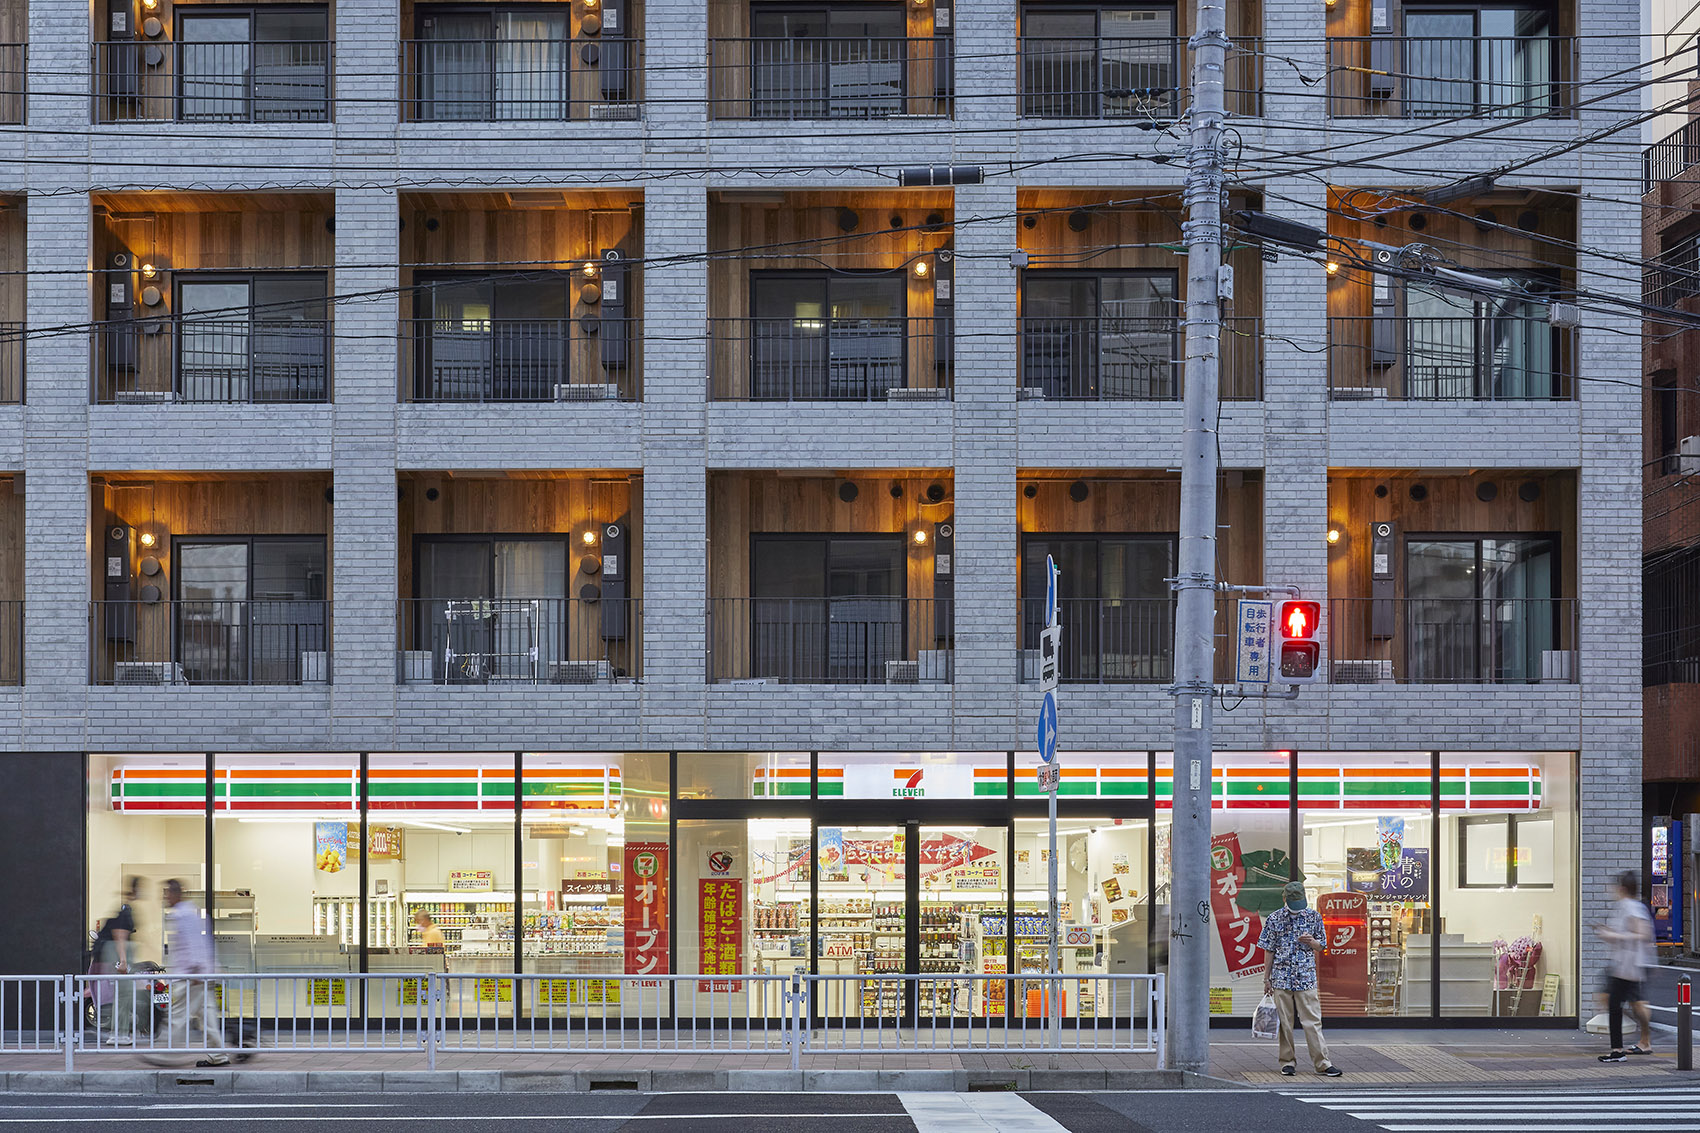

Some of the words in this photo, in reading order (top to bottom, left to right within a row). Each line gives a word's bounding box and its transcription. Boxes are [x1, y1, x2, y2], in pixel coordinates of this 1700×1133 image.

[1244, 608, 1256, 647] 自転車
[1255, 609, 1267, 648] 歩行者
[1248, 651, 1260, 677] 専用
[566, 884, 611, 893] スイーツ売場
[1401, 856, 1414, 889] 青の
[1216, 872, 1256, 966] オープン
[1325, 899, 1353, 910] ATM
[634, 881, 658, 975] オープン
[703, 882, 717, 975] 年齢確認実施中
[827, 946, 853, 955] ATM
